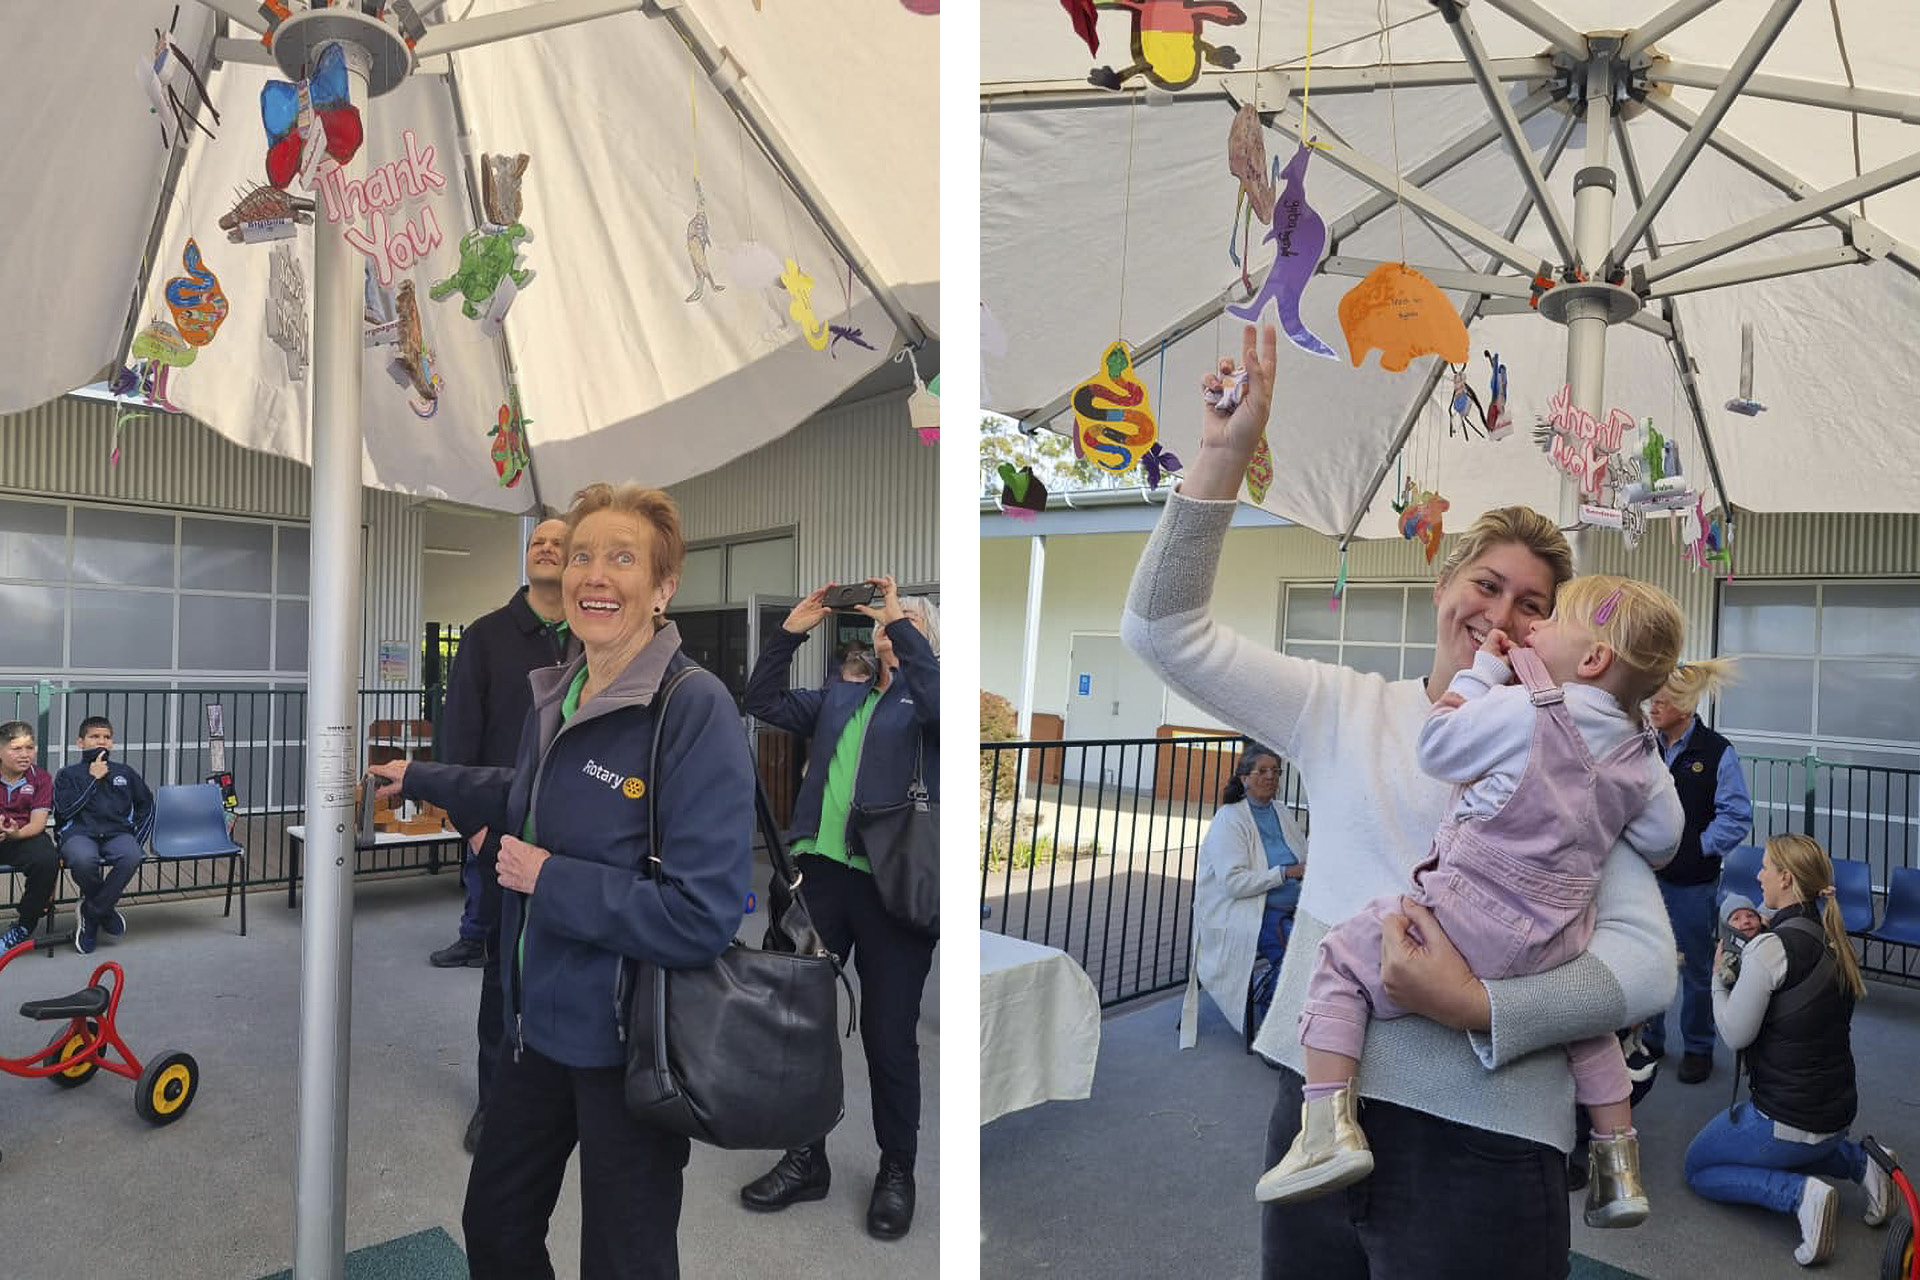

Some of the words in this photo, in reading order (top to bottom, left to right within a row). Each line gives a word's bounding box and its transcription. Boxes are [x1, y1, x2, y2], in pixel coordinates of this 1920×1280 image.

[312, 131, 446, 222] Thank
[344, 206, 442, 285] You
[583, 760, 624, 789] Rotary
